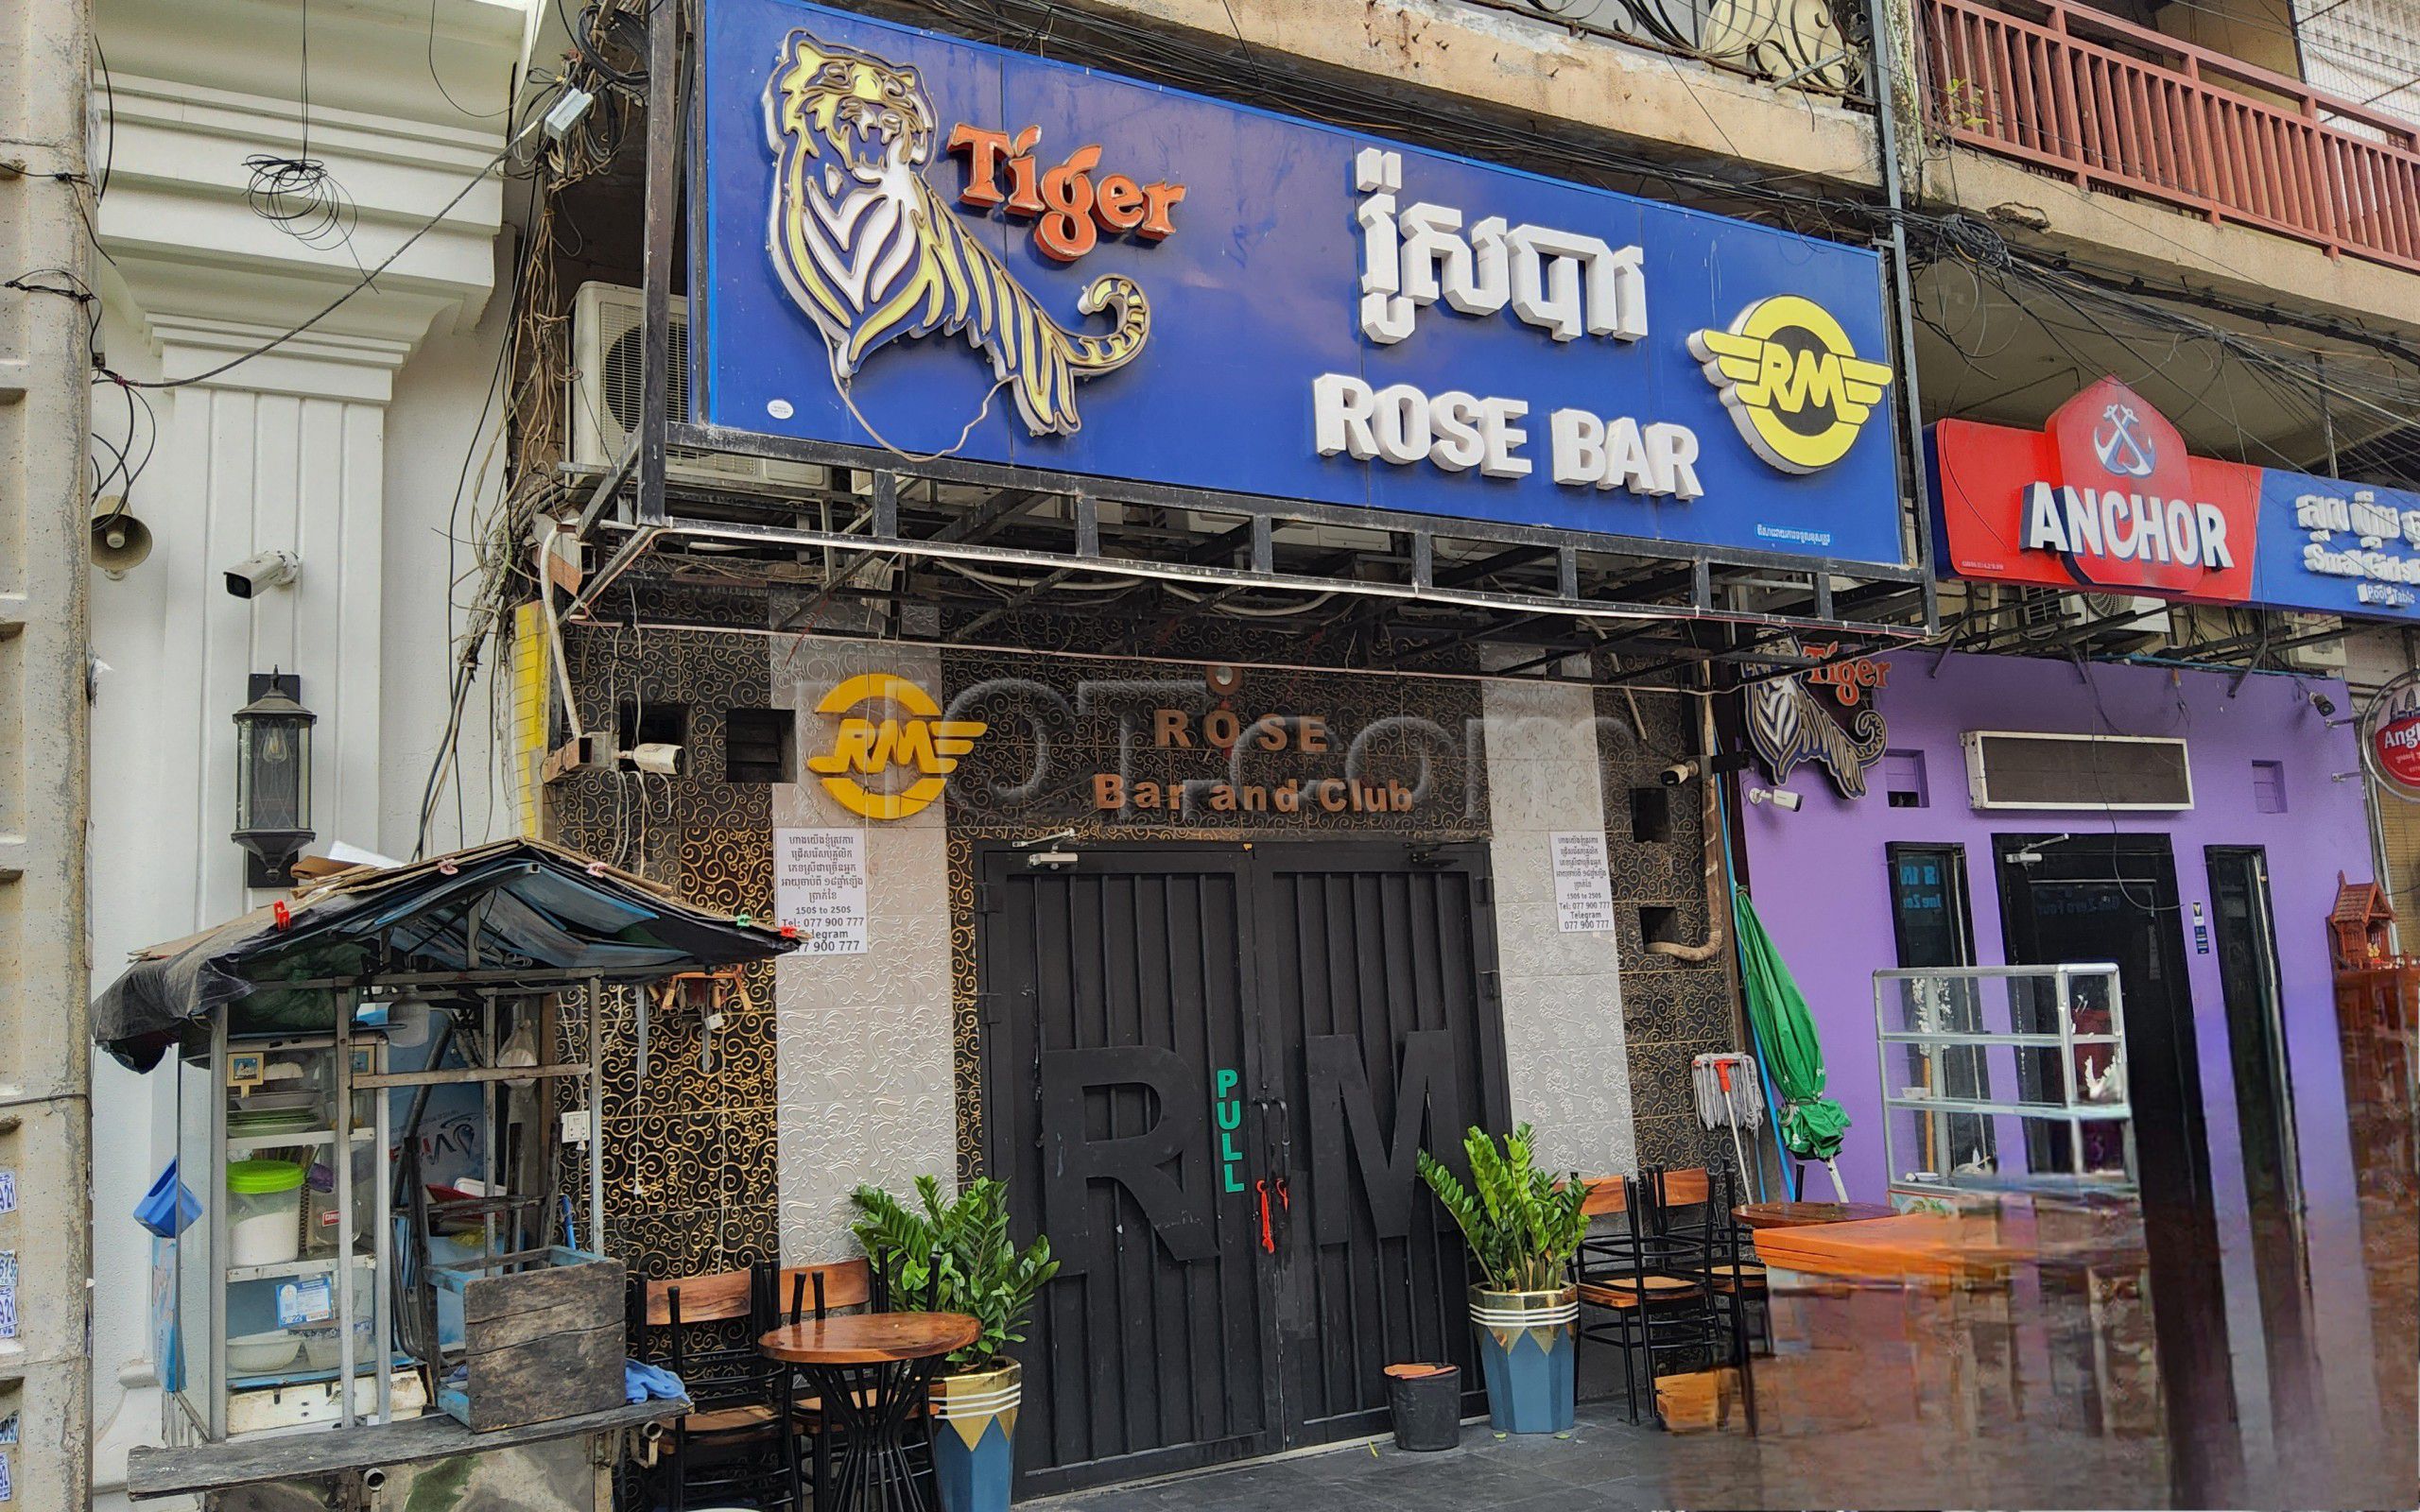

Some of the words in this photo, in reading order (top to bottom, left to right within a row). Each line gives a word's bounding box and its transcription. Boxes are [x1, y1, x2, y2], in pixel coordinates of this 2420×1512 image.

[948, 123, 1185, 261] Tiger
[1313, 373, 1532, 479] ROSE
[1550, 408, 1703, 501] BAR
[2021, 481, 2235, 570] ANCHOR
[2358, 583, 2388, 603] Pool
[1803, 642, 1892, 707] Tiger
[1153, 708, 1328, 753] ROSE
[1093, 773, 1185, 811] Bar
[1210, 778, 1299, 813] and
[1318, 778, 1413, 814] Club
[795, 906, 817, 915] 150$
[830, 905, 852, 914] 250$
[804, 919, 821, 927] 077
[825, 918, 843, 927] 900
[847, 917, 865, 926] 777
[1564, 920, 1578, 929] 077
[1580, 920, 1595, 929] 900
[1597, 919, 1610, 929] 777
[1570, 911, 1601, 921] Telegram
[813, 941, 835, 952] 900
[838, 940, 860, 951] 777
[1217, 1069, 1245, 1194] PULL
